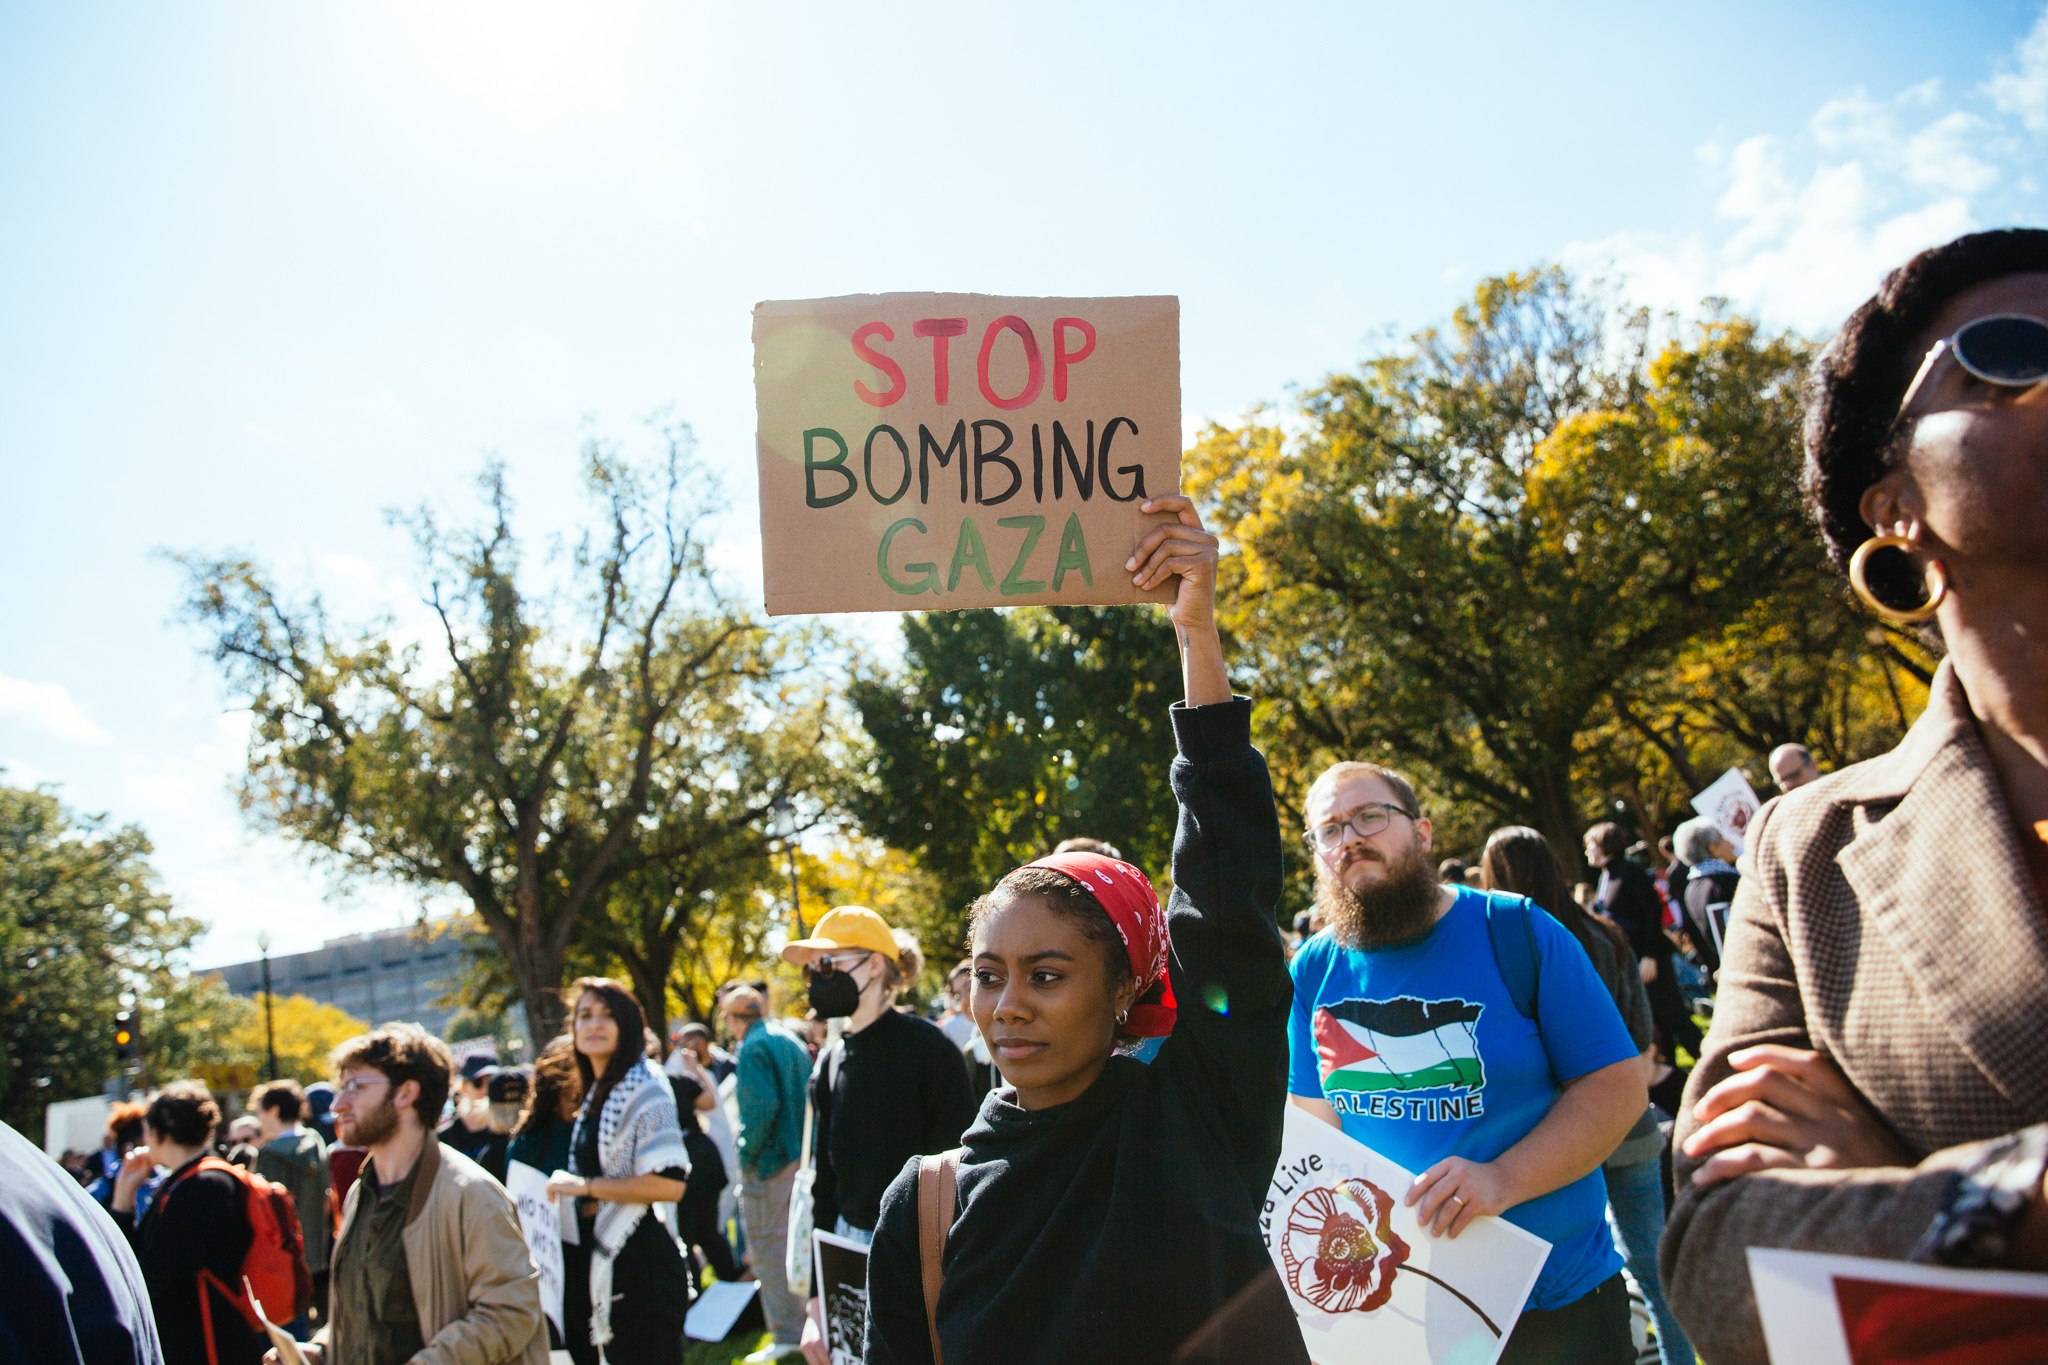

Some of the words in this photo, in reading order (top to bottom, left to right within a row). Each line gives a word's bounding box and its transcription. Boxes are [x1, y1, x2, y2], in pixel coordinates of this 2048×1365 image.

[852, 315, 1096, 410] STOP
[803, 417, 1148, 508] BOMBING
[877, 512, 1094, 596] GAZA
[1273, 1154, 1323, 1196] Live
